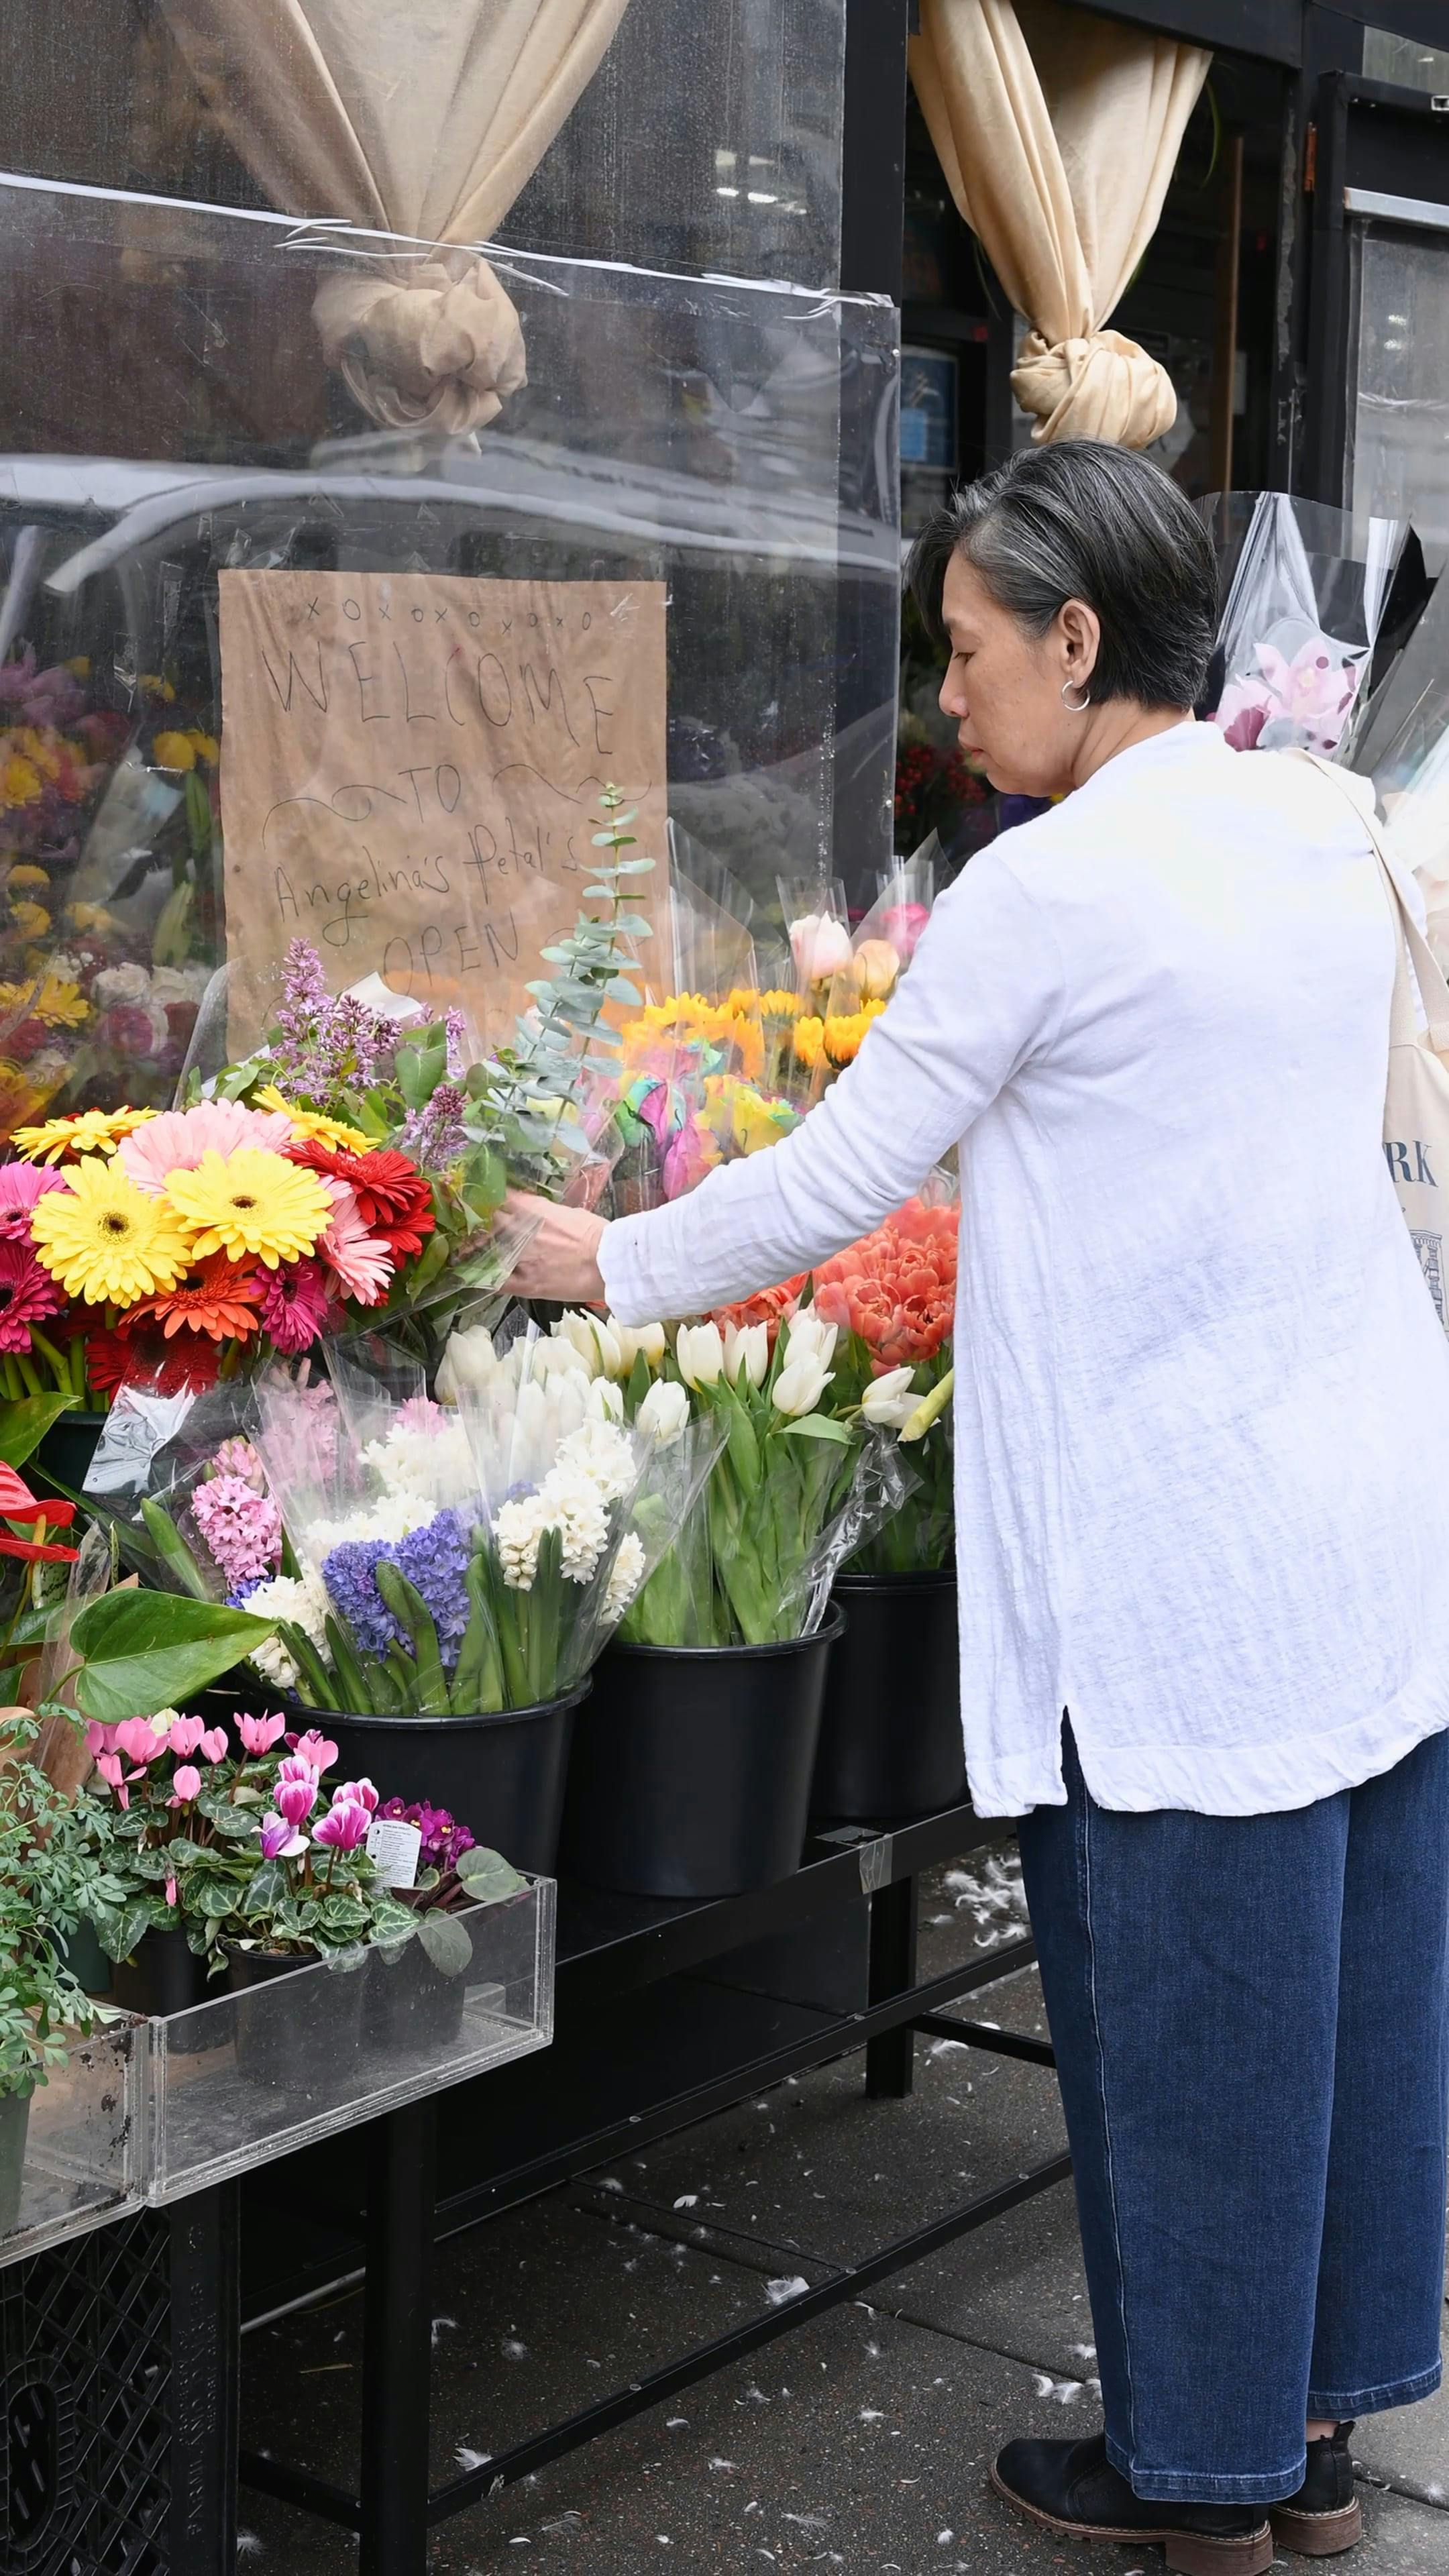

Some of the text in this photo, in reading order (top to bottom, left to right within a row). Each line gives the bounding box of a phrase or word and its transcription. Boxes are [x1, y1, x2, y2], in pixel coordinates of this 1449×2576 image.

[261, 641, 614, 755] WELCOME
[398, 763, 462, 823] TO
[272, 846, 450, 947] Angelina's
[383, 911, 519, 996] OPEN
[1383, 1140, 1439, 1187] RK
